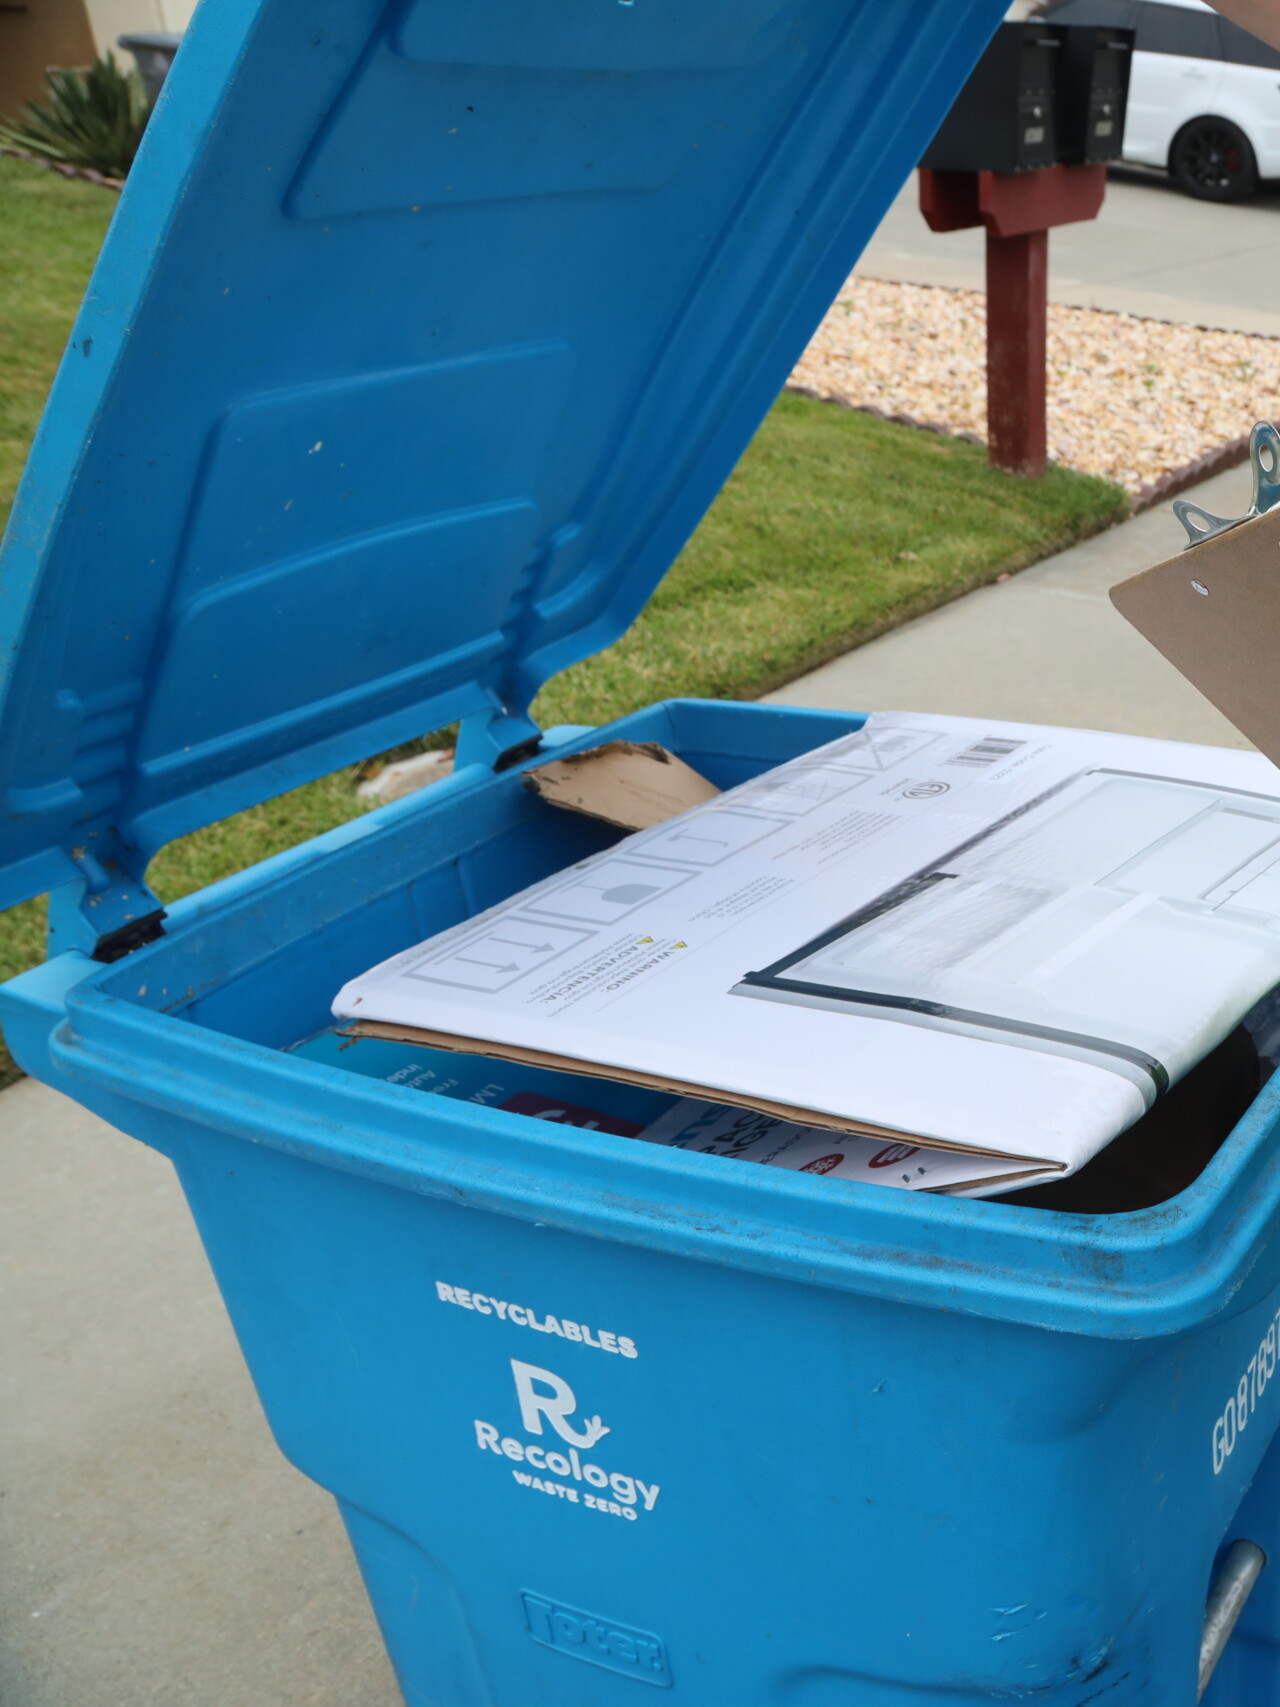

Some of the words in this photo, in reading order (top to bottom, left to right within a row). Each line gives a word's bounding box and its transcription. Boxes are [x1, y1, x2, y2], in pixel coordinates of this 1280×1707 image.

[533, 945, 646, 1005] ADVERTENCIA:
[594, 950, 682, 994] WARNING:
[435, 1280, 638, 1358] RECYCLABLES
[510, 1358, 608, 1449] R
[473, 1419, 660, 1511] Recology
[512, 1470, 579, 1504] WASTE
[584, 1493, 638, 1521] ZERO
